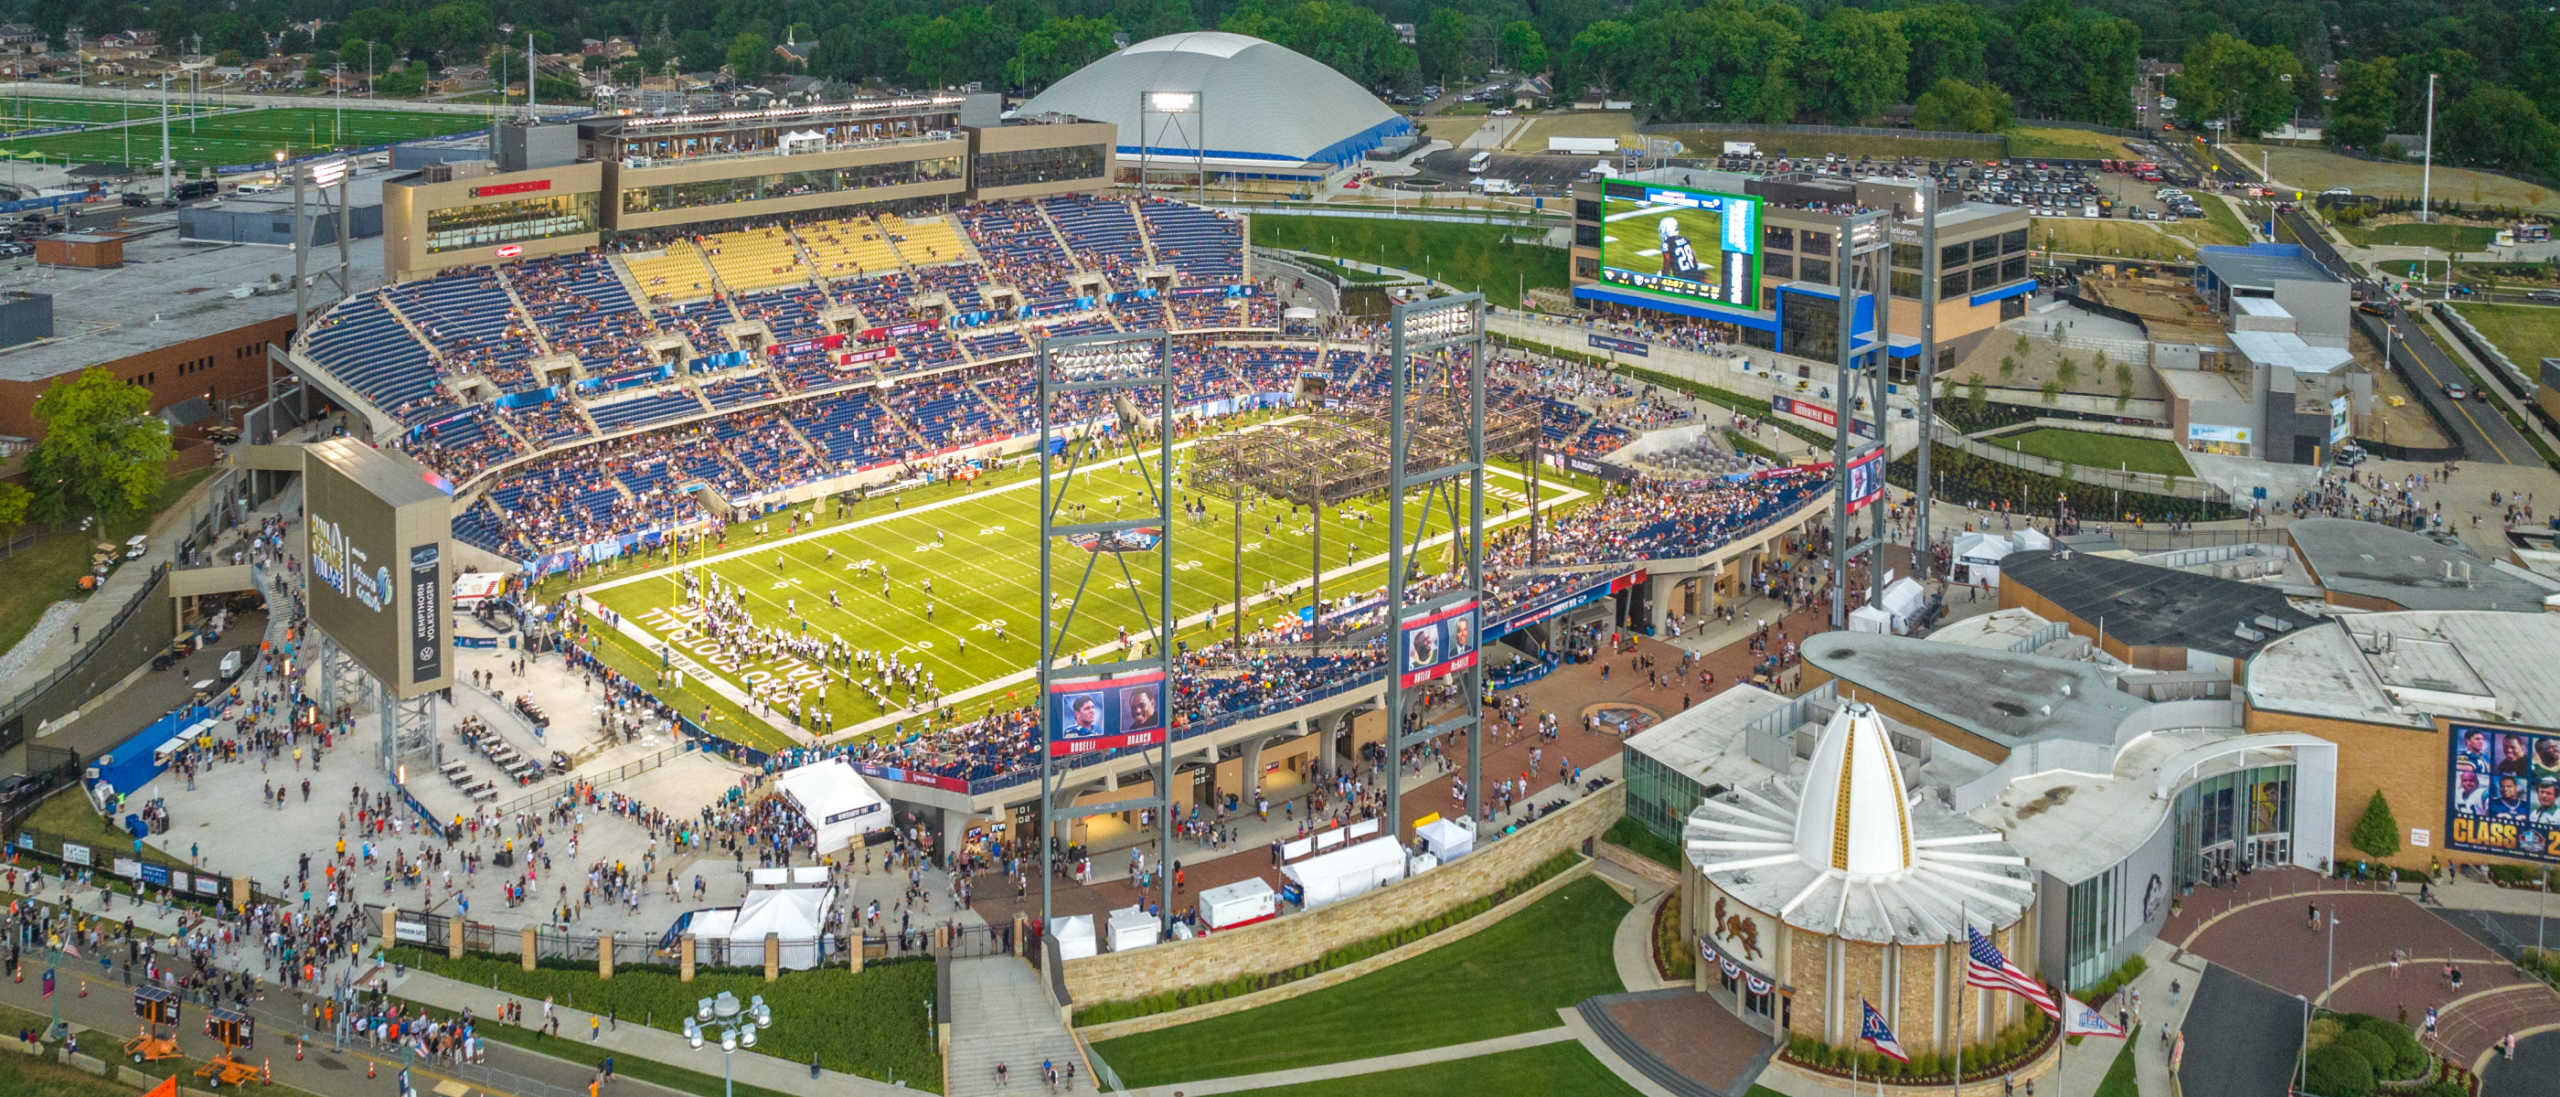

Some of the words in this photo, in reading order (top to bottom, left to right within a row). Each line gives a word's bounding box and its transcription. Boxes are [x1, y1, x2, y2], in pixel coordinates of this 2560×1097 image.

[416, 583, 426, 639] KEMPTHORN
[425, 581, 435, 642] VOLKSWAGEN
[2453, 818, 2518, 850] CLASS
